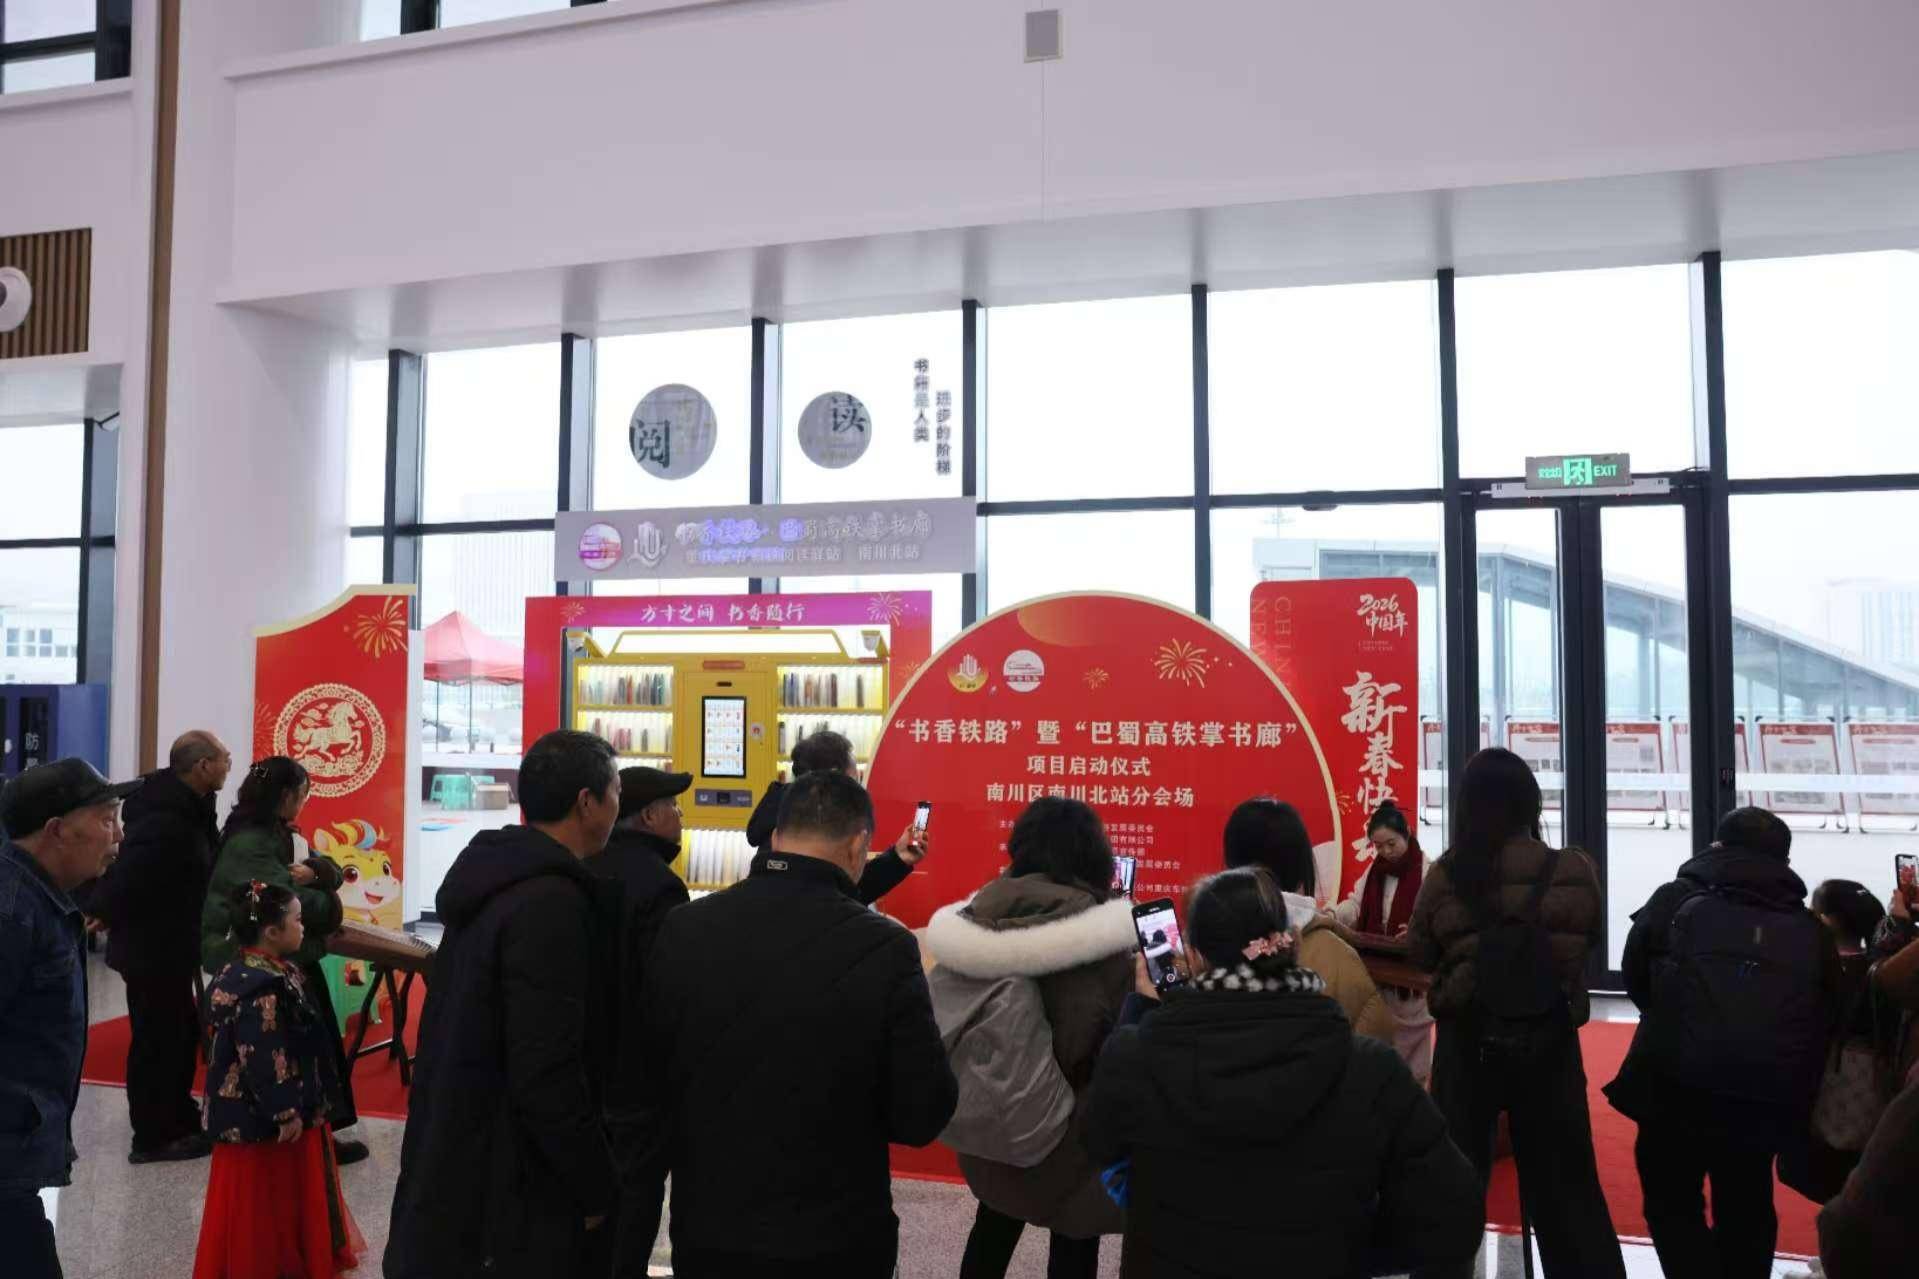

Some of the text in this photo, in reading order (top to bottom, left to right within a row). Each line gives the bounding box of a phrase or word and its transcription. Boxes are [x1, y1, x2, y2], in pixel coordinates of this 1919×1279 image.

[831, 394, 867, 433] 读
[629, 419, 671, 469] 阅
[1594, 464, 1617, 477] EXIT
[641, 602, 805, 623] 方寸之间 书香随行
[1357, 593, 1399, 616] 2026
[1274, 596, 1292, 674] CHIN
[1365, 611, 1408, 637] 中国年
[1036, 719, 1060, 745] 暨
[1027, 755, 1151, 777] 项目启动仪式
[986, 783, 1195, 808] 南川区南川北站分会场
